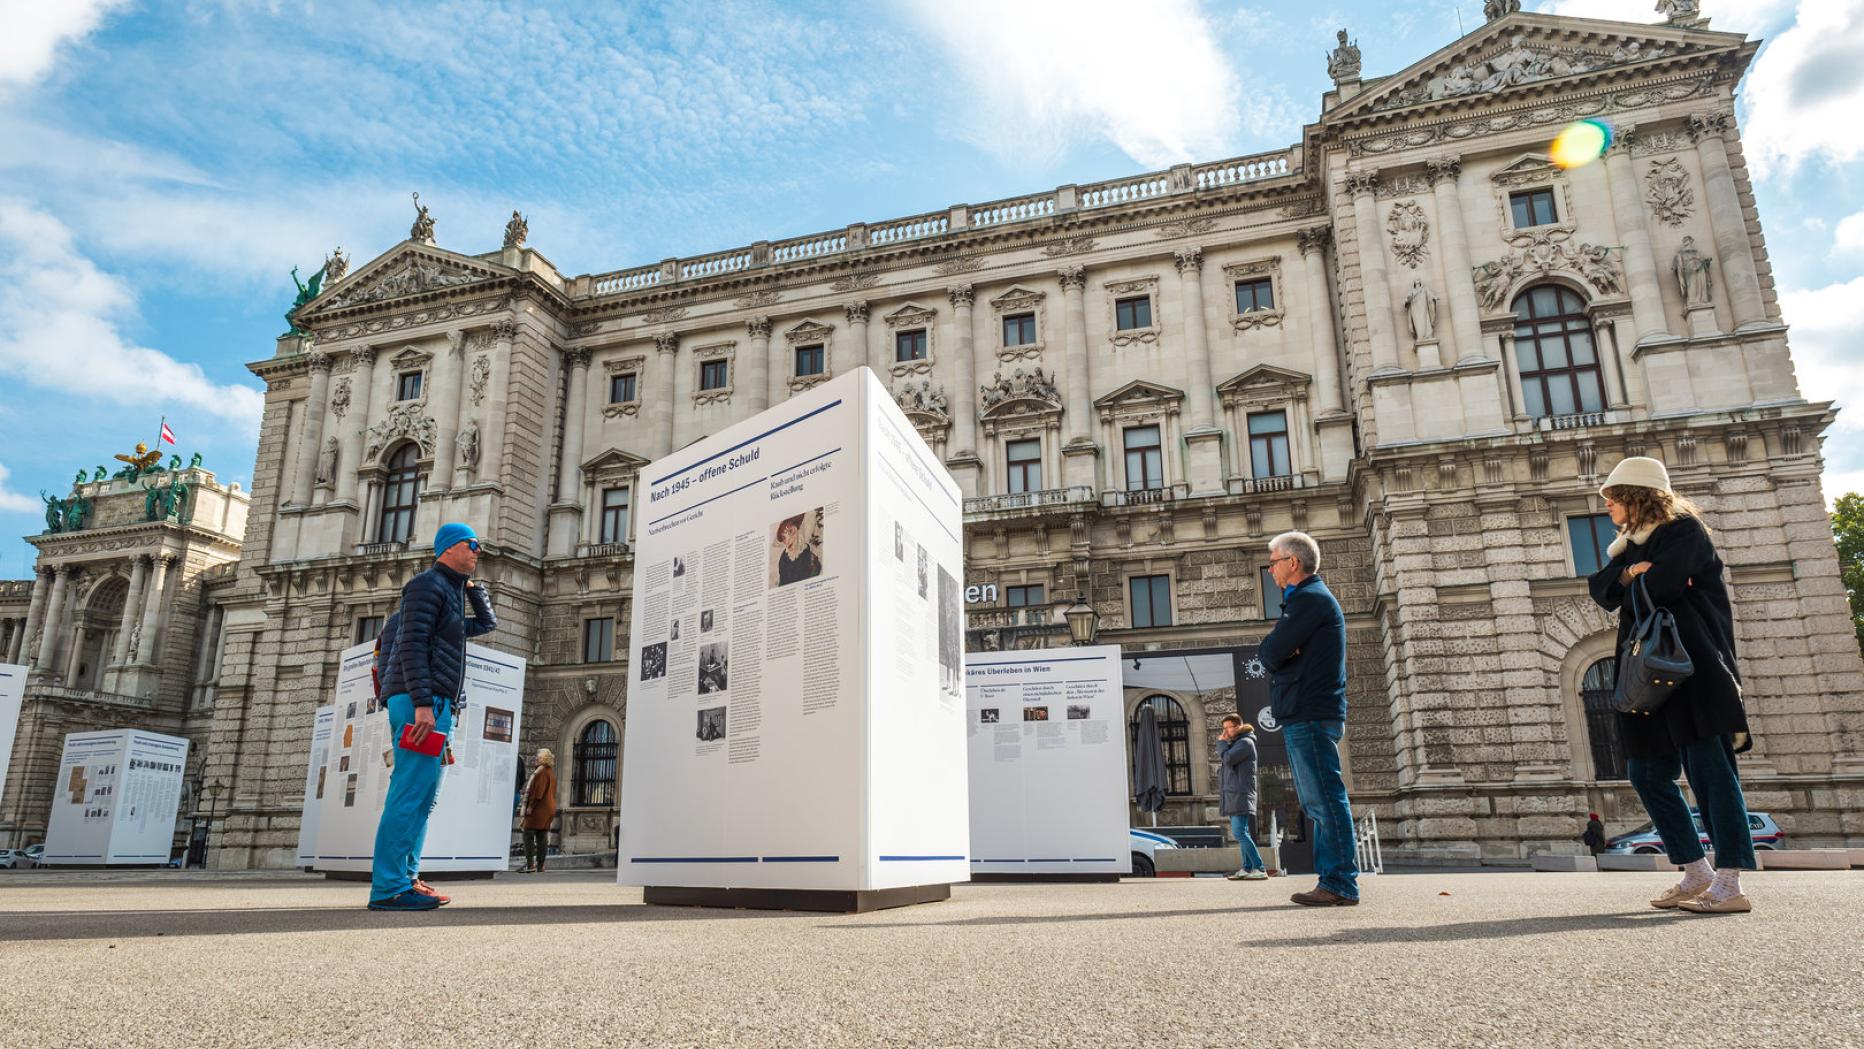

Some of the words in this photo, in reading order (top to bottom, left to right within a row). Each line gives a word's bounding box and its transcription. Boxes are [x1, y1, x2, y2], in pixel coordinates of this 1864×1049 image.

[650, 486, 670, 503] Nach
[671, 477, 690, 495] 1945
[699, 463, 727, 483] offene
[729, 447, 760, 470] Schuld
[965, 584, 997, 604] en
[987, 666, 1023, 675] Überleben
[1032, 665, 1051, 673] Wien
